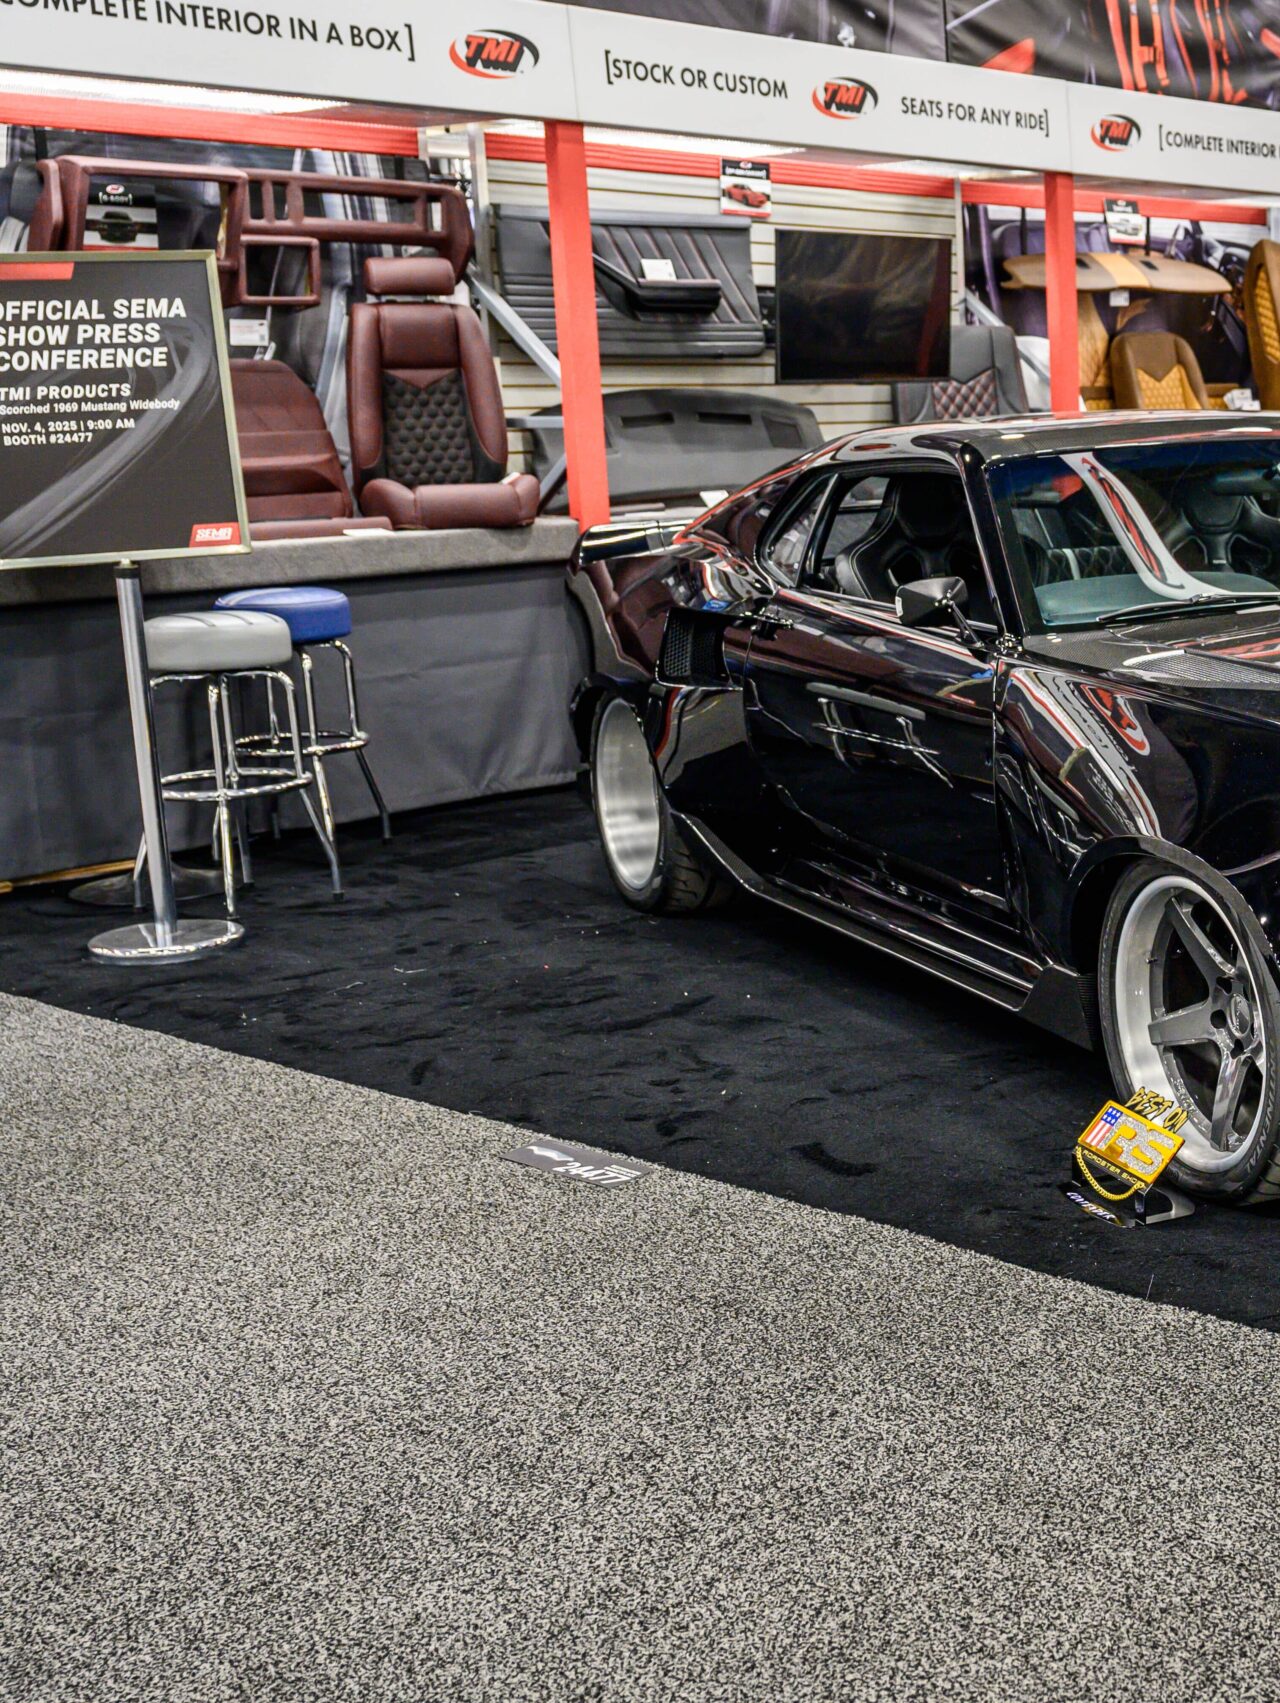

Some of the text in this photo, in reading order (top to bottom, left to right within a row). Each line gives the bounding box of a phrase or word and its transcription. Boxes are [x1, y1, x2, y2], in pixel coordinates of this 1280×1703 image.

[156, 3, 282, 38] INTERIOR
[289, 17, 318, 42] IN
[326, 23, 343, 45] A
[465, 34, 525, 72] TMI
[680, 67, 708, 89] OR
[713, 71, 789, 99] CUSTOM
[823, 82, 868, 114] TMI
[901, 96, 944, 118] SEATS
[948, 103, 977, 123] FOR
[980, 108, 1011, 128] ANY
[1099, 118, 1134, 146] TMI
[1226, 139, 1277, 159] INTERIOR
[0, 298, 186, 321] FFICIAL SEMA
[77, 323, 161, 345] PRESS
[0, 347, 168, 372] CONFERENCE
[0, 383, 132, 401] TMI PRODUCTS
[0, 398, 180, 415] Scorched 1969 Mustang Widebody
[2, 422, 31, 434] NOV.
[48, 420, 77, 432] 2025
[87, 418, 113, 430] 9:00
[116, 418, 136, 429] AM
[3, 431, 93, 446] BOOTH #24477
[195, 527, 233, 542] SEMA
[1125, 1086, 1191, 1133] BEST ON
[1082, 1149, 1121, 1175] ROADSTER
